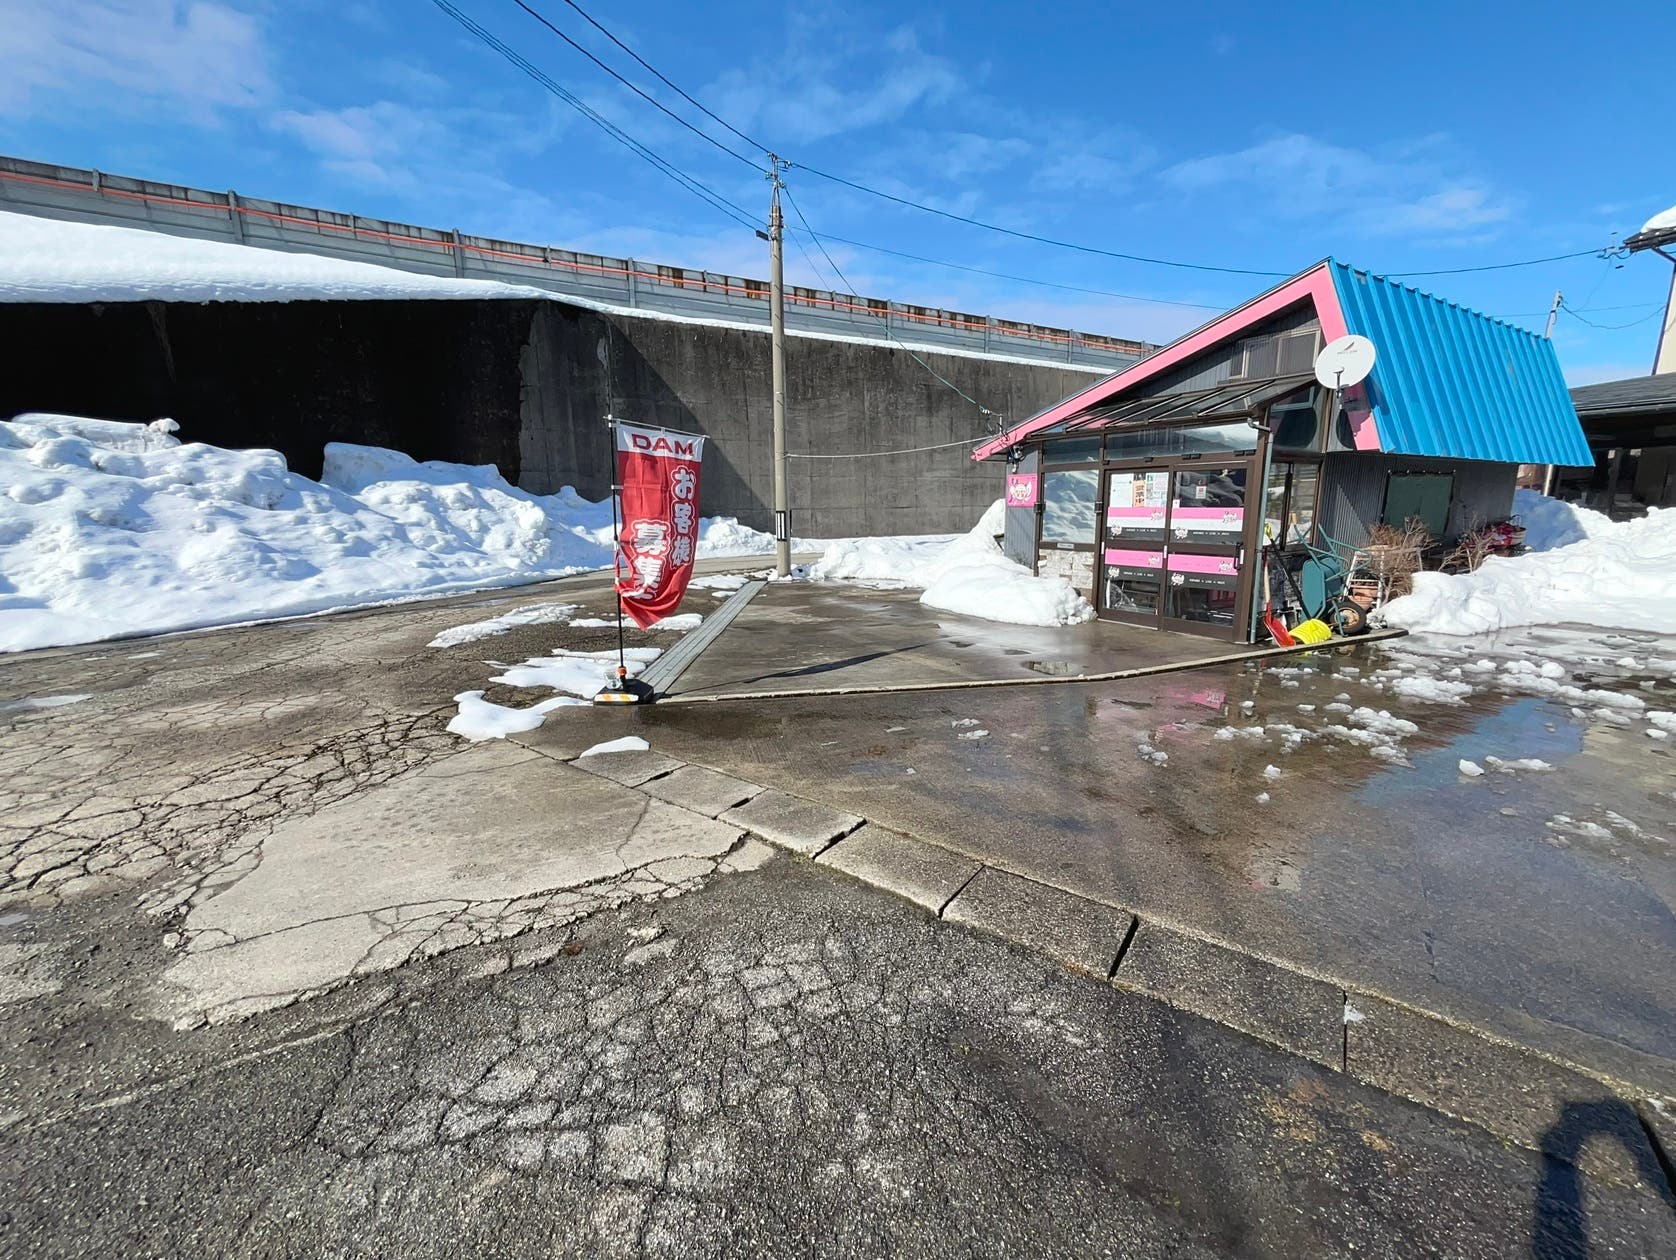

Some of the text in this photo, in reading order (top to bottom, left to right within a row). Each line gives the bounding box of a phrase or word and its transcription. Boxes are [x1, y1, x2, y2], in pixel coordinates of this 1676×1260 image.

[631, 433, 694, 457] DAM
[671, 467, 696, 568] お客様
[625, 522, 669, 600] 募集
